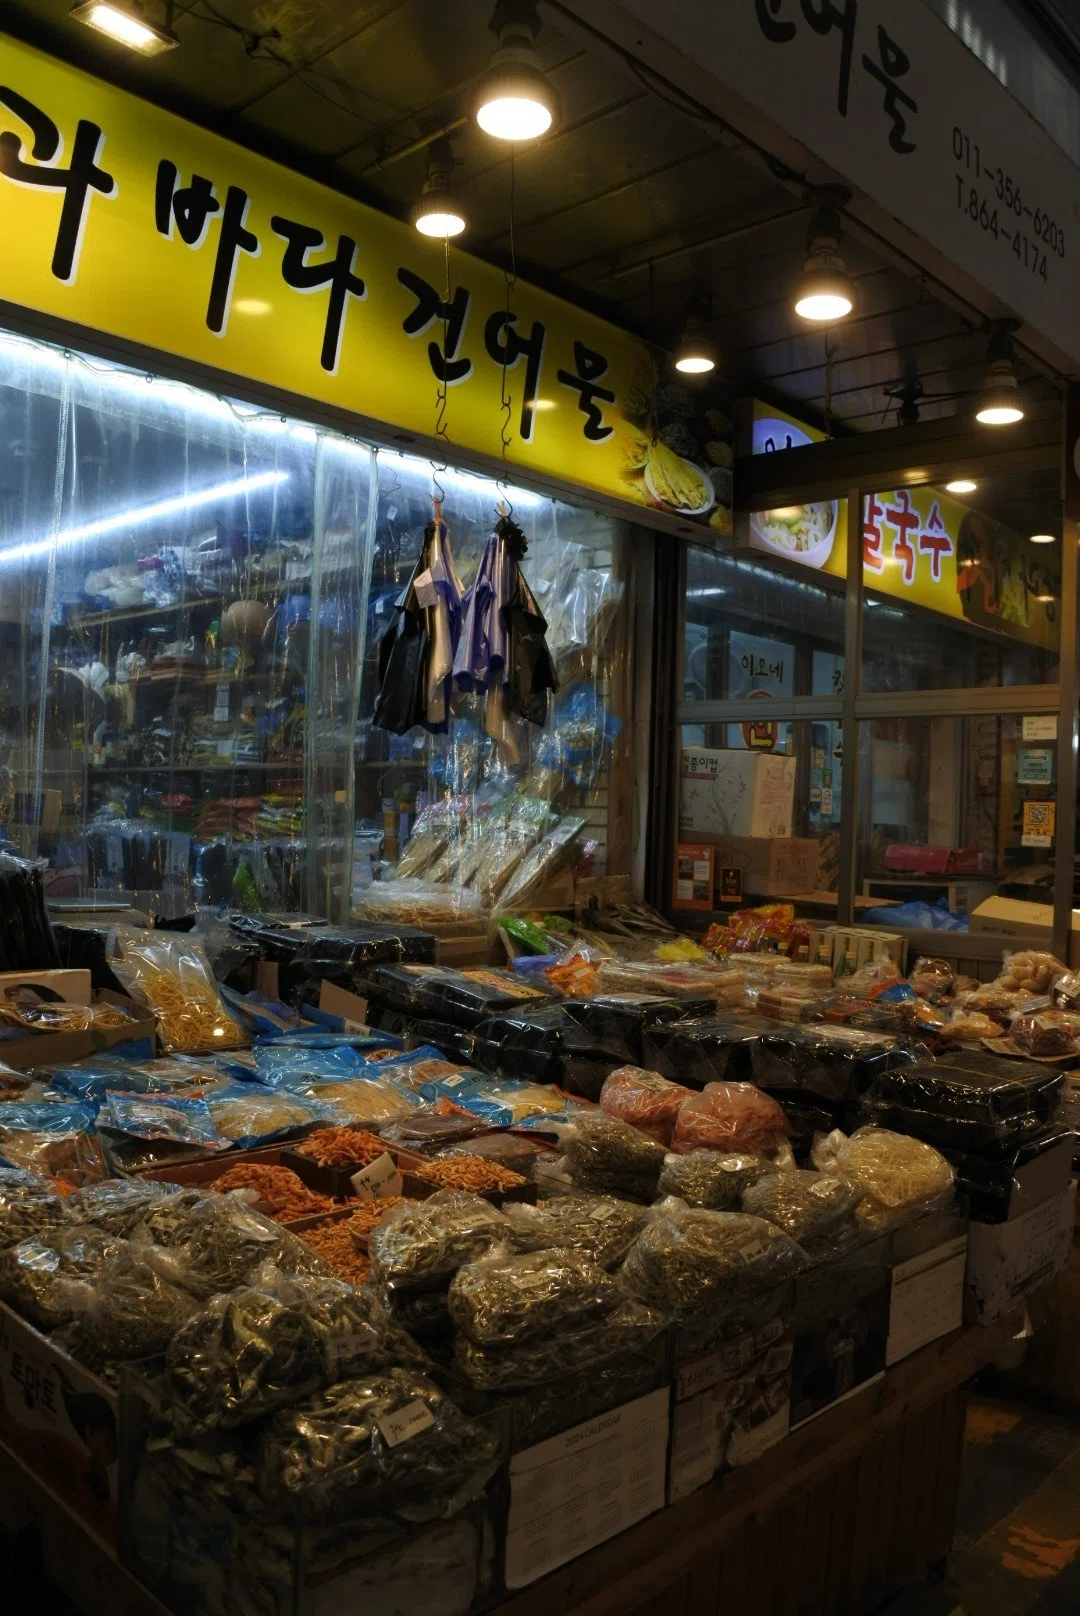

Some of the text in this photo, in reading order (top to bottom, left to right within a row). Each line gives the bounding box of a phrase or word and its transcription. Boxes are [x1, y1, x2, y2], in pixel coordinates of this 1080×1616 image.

[952, 126, 1065, 258] 011-356-6203
[954, 174, 1050, 284] T.864-4174
[156, 159, 365, 372] 바다
[397, 267, 617, 441] 건어물
[690, 757, 718, 773] 종이컵
[584, 1414, 623, 1439] CALENDAR
